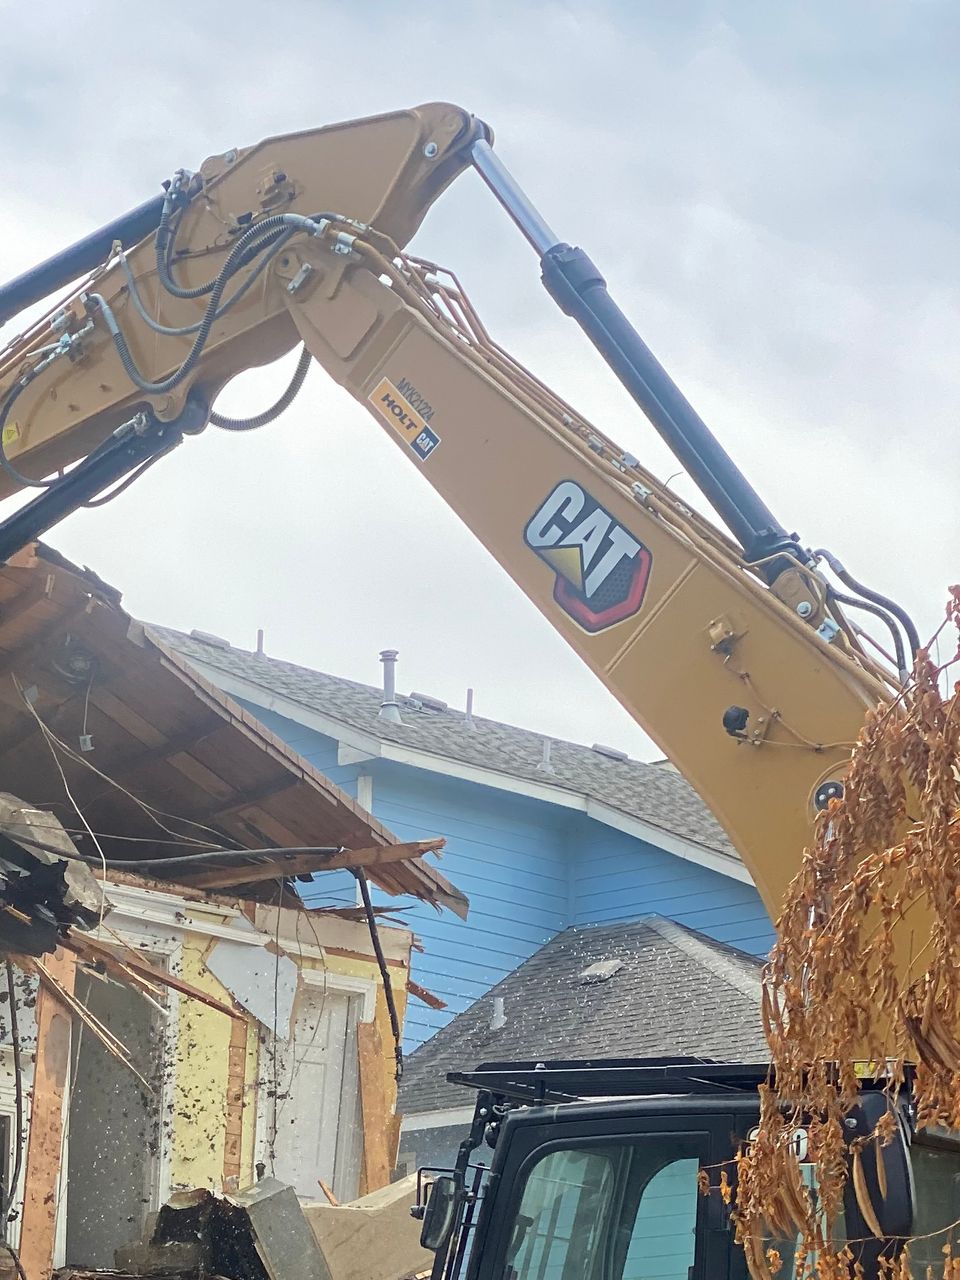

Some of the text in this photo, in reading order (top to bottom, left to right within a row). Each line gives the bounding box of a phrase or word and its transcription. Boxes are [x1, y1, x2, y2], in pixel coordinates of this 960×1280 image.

[381, 393, 434, 452] HOLT CAT
[526, 480, 642, 598] CAT
